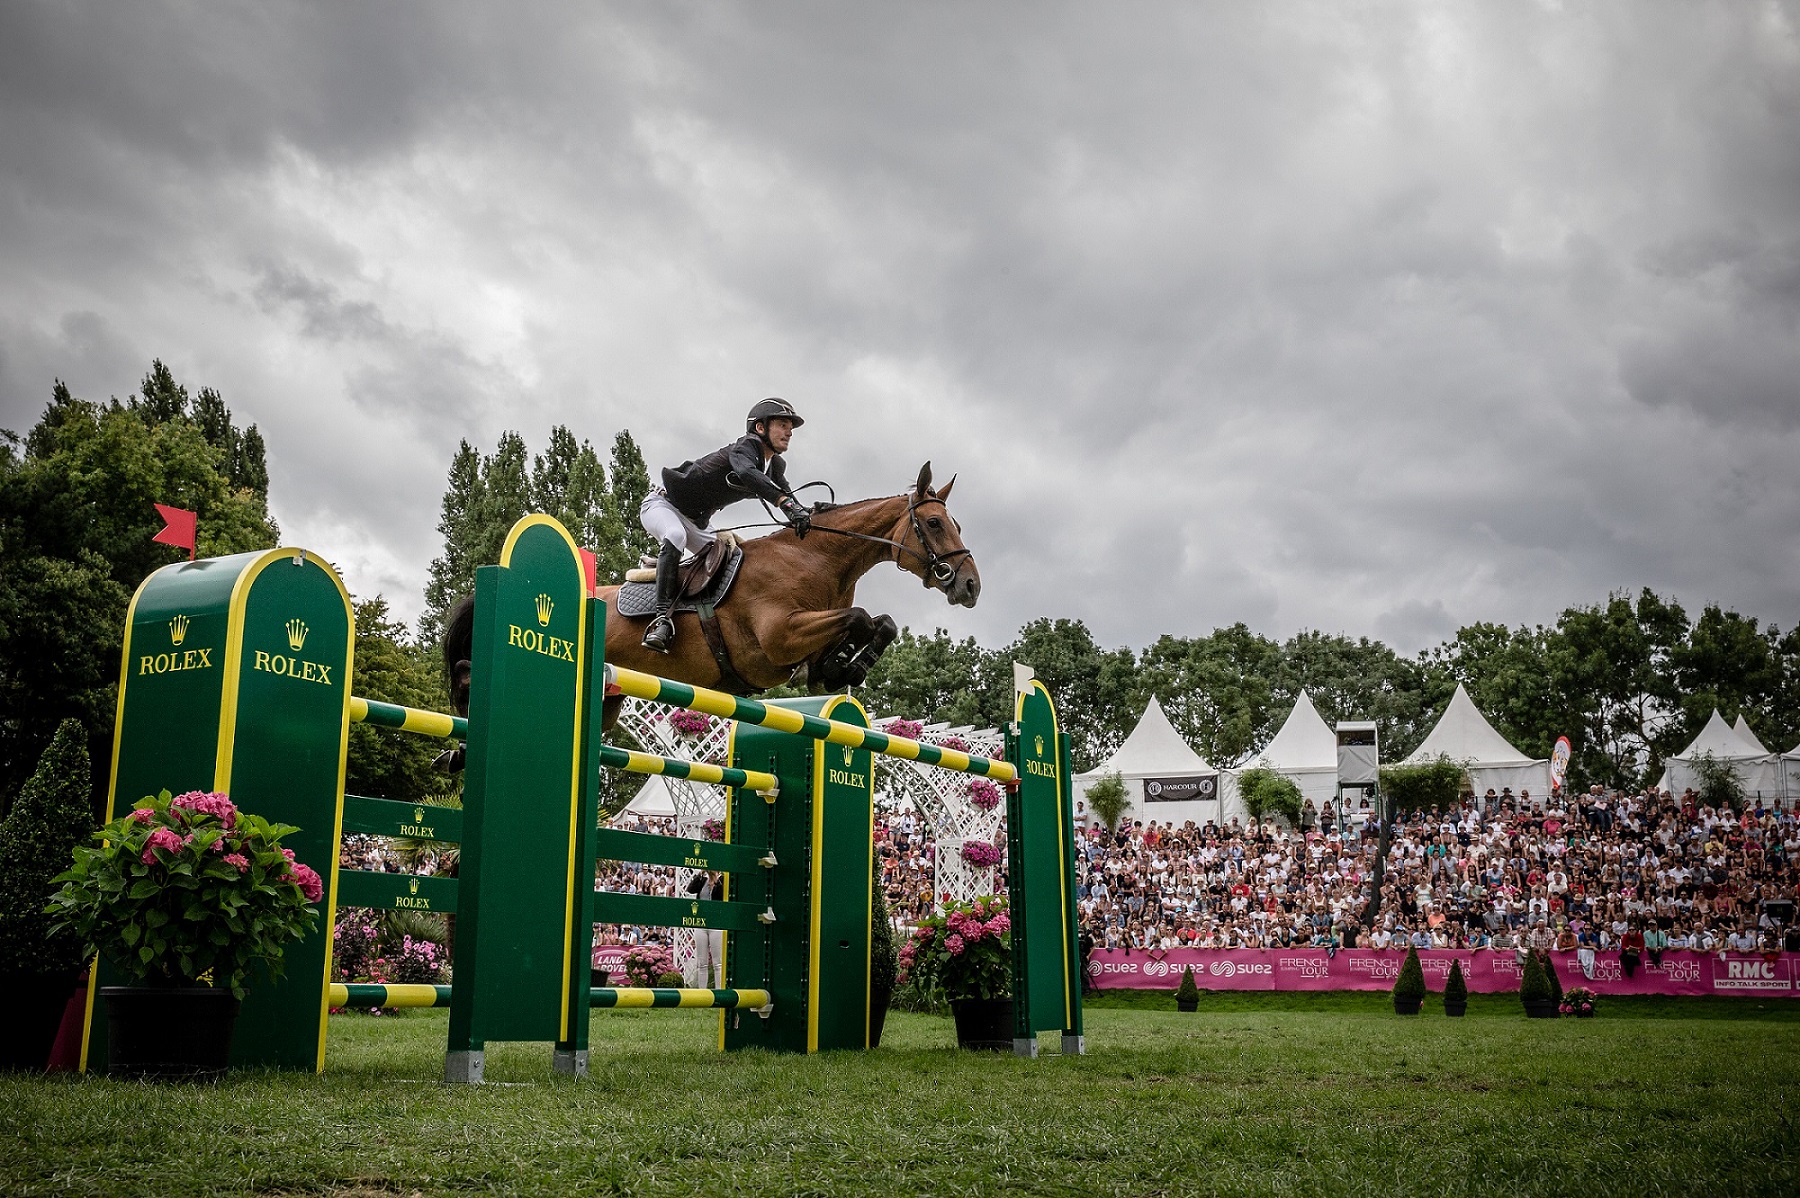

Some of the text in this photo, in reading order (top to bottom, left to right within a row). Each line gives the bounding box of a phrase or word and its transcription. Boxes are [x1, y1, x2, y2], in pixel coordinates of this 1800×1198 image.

[508, 624, 575, 663] ROLEX
[138, 648, 213, 676] ROLEX
[254, 650, 332, 686] ROLEX
[829, 769, 865, 788] ROLEX
[1163, 783, 1197, 791] HARCOUR
[400, 824, 435, 838] ROLEX
[684, 857, 708, 868] ROLEX
[395, 896, 430, 909] ROLEX
[682, 917, 706, 927] ROLEX
[598, 956, 623, 965] LAND
[1280, 958, 1329, 967] FRENCH
[1349, 958, 1399, 967] FRENCH
[1104, 963, 1138, 973] suez
[1237, 963, 1272, 974] suez
[1301, 966, 1329, 975] TOUR
[1371, 967, 1399, 976] TOUR
[1728, 961, 1776, 979] RMC
[1669, 969, 1700, 979] TOUR
